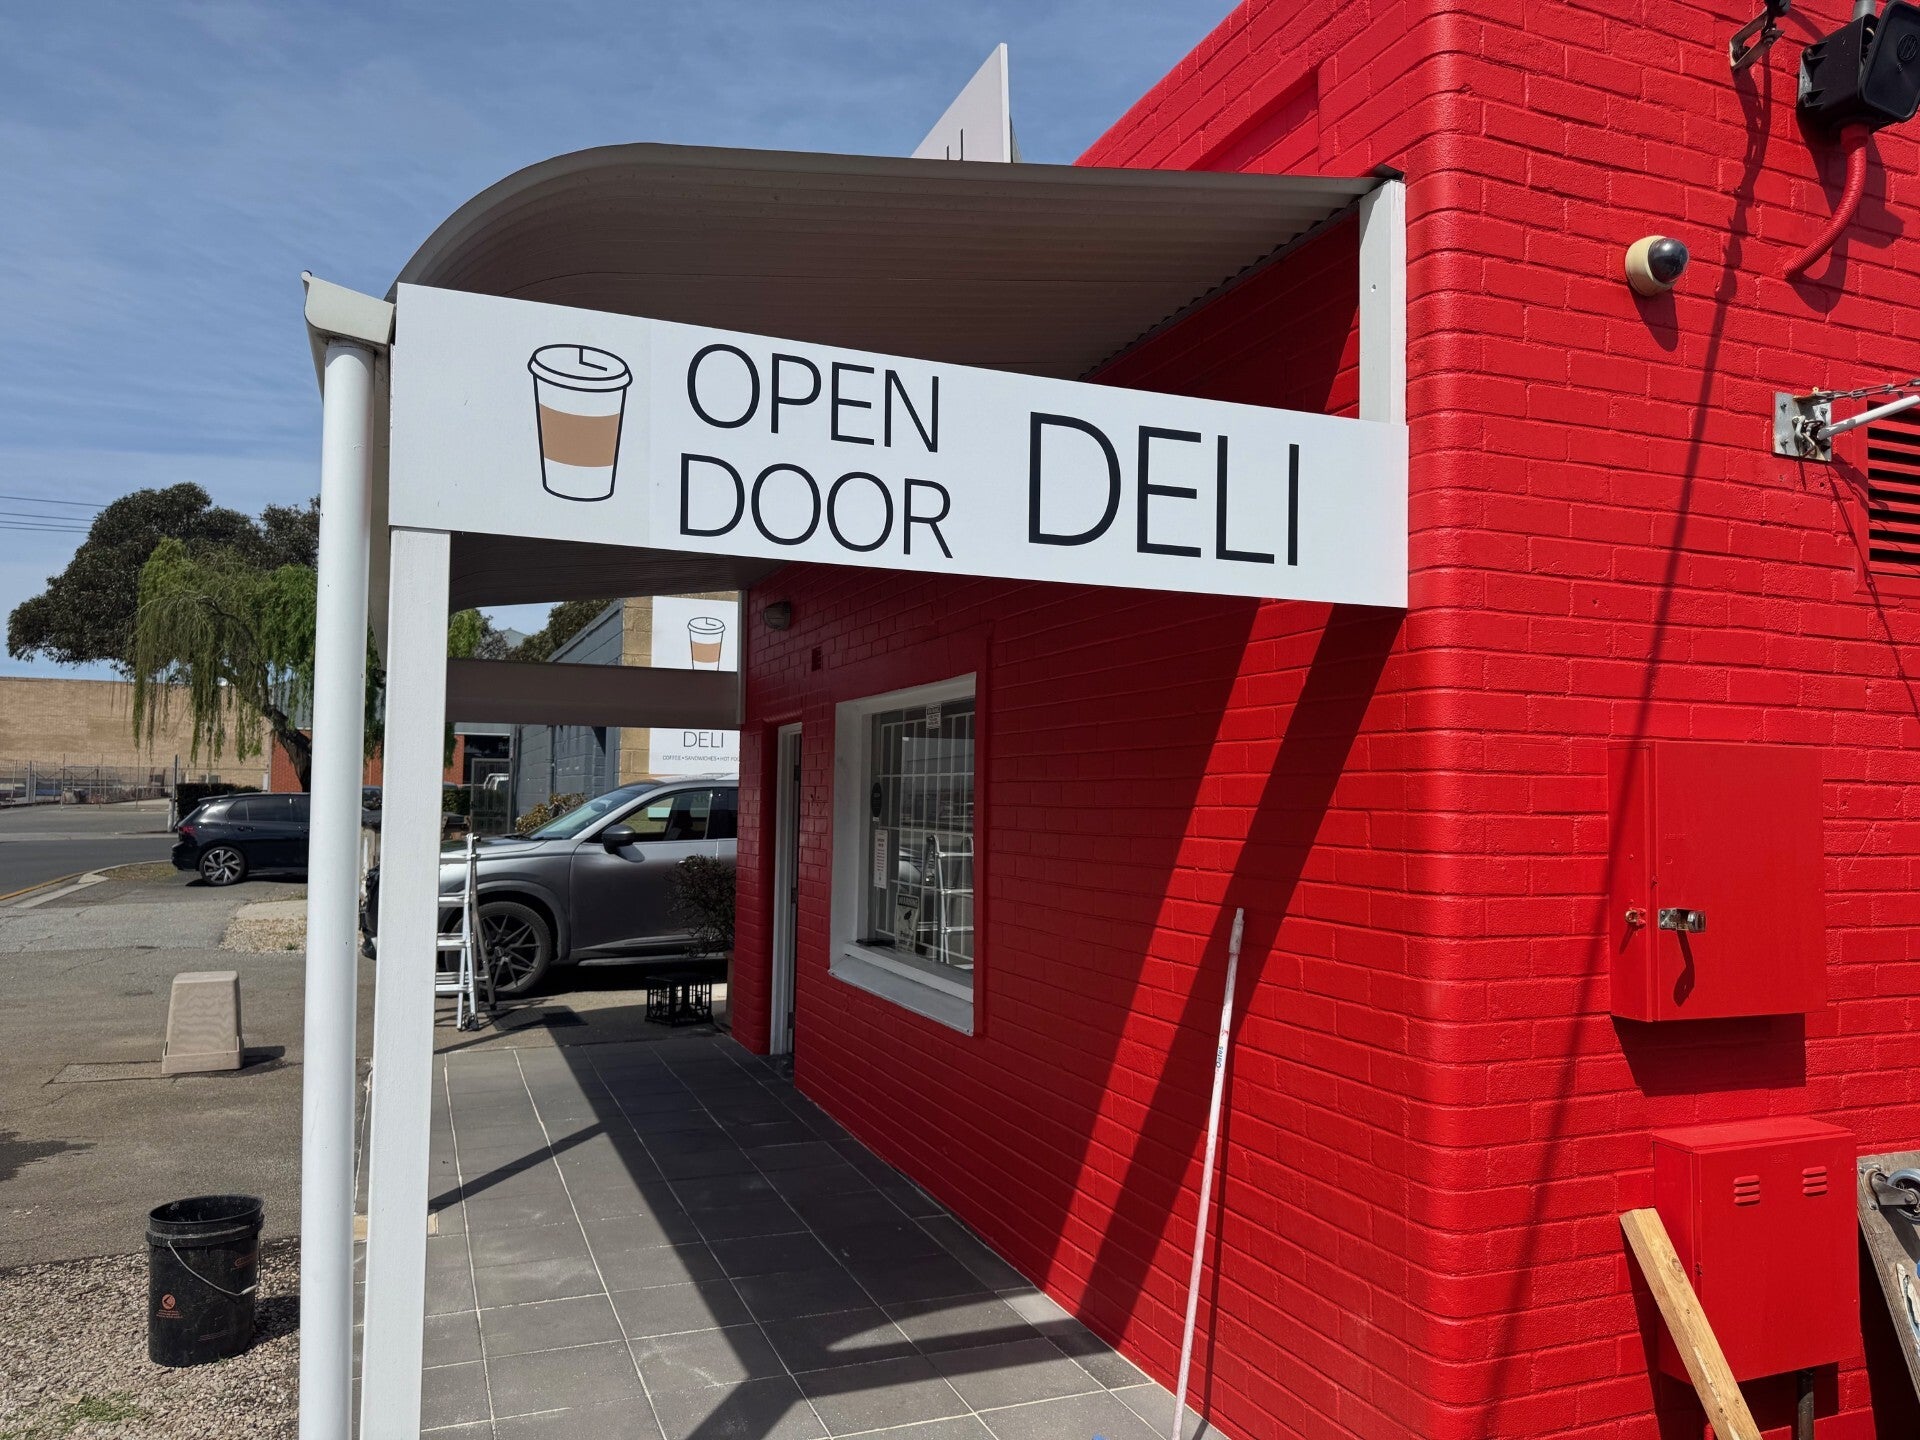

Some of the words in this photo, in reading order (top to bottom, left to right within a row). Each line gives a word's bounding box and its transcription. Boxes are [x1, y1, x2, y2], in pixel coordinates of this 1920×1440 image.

[686, 343, 940, 454] OPEN
[679, 452, 954, 559] DOOR
[1028, 411, 1300, 567] DELI
[683, 731, 724, 748] DELI
